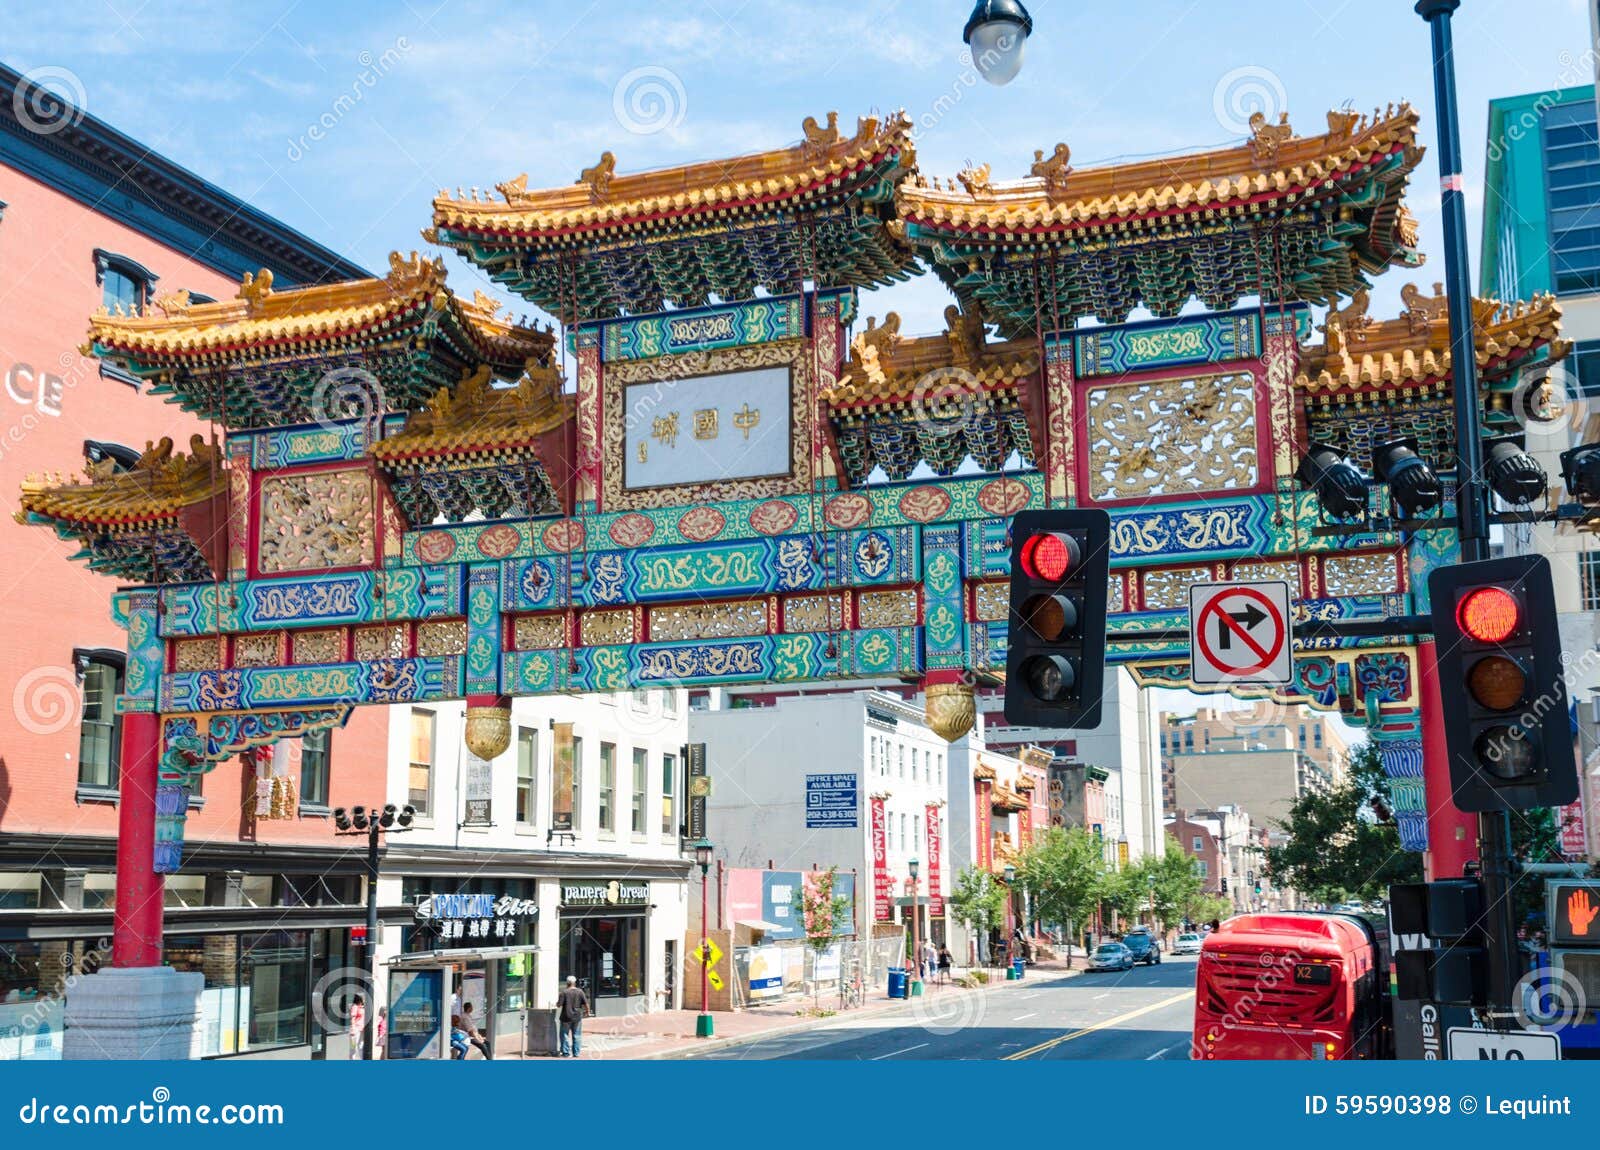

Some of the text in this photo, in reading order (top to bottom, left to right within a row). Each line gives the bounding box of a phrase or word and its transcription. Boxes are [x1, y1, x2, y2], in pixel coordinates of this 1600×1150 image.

[873, 801, 885, 861] VAPIANO
[928, 808, 941, 864] VAPIANO
[564, 883, 649, 904] panera bread
[1296, 967, 1312, 979] X2
